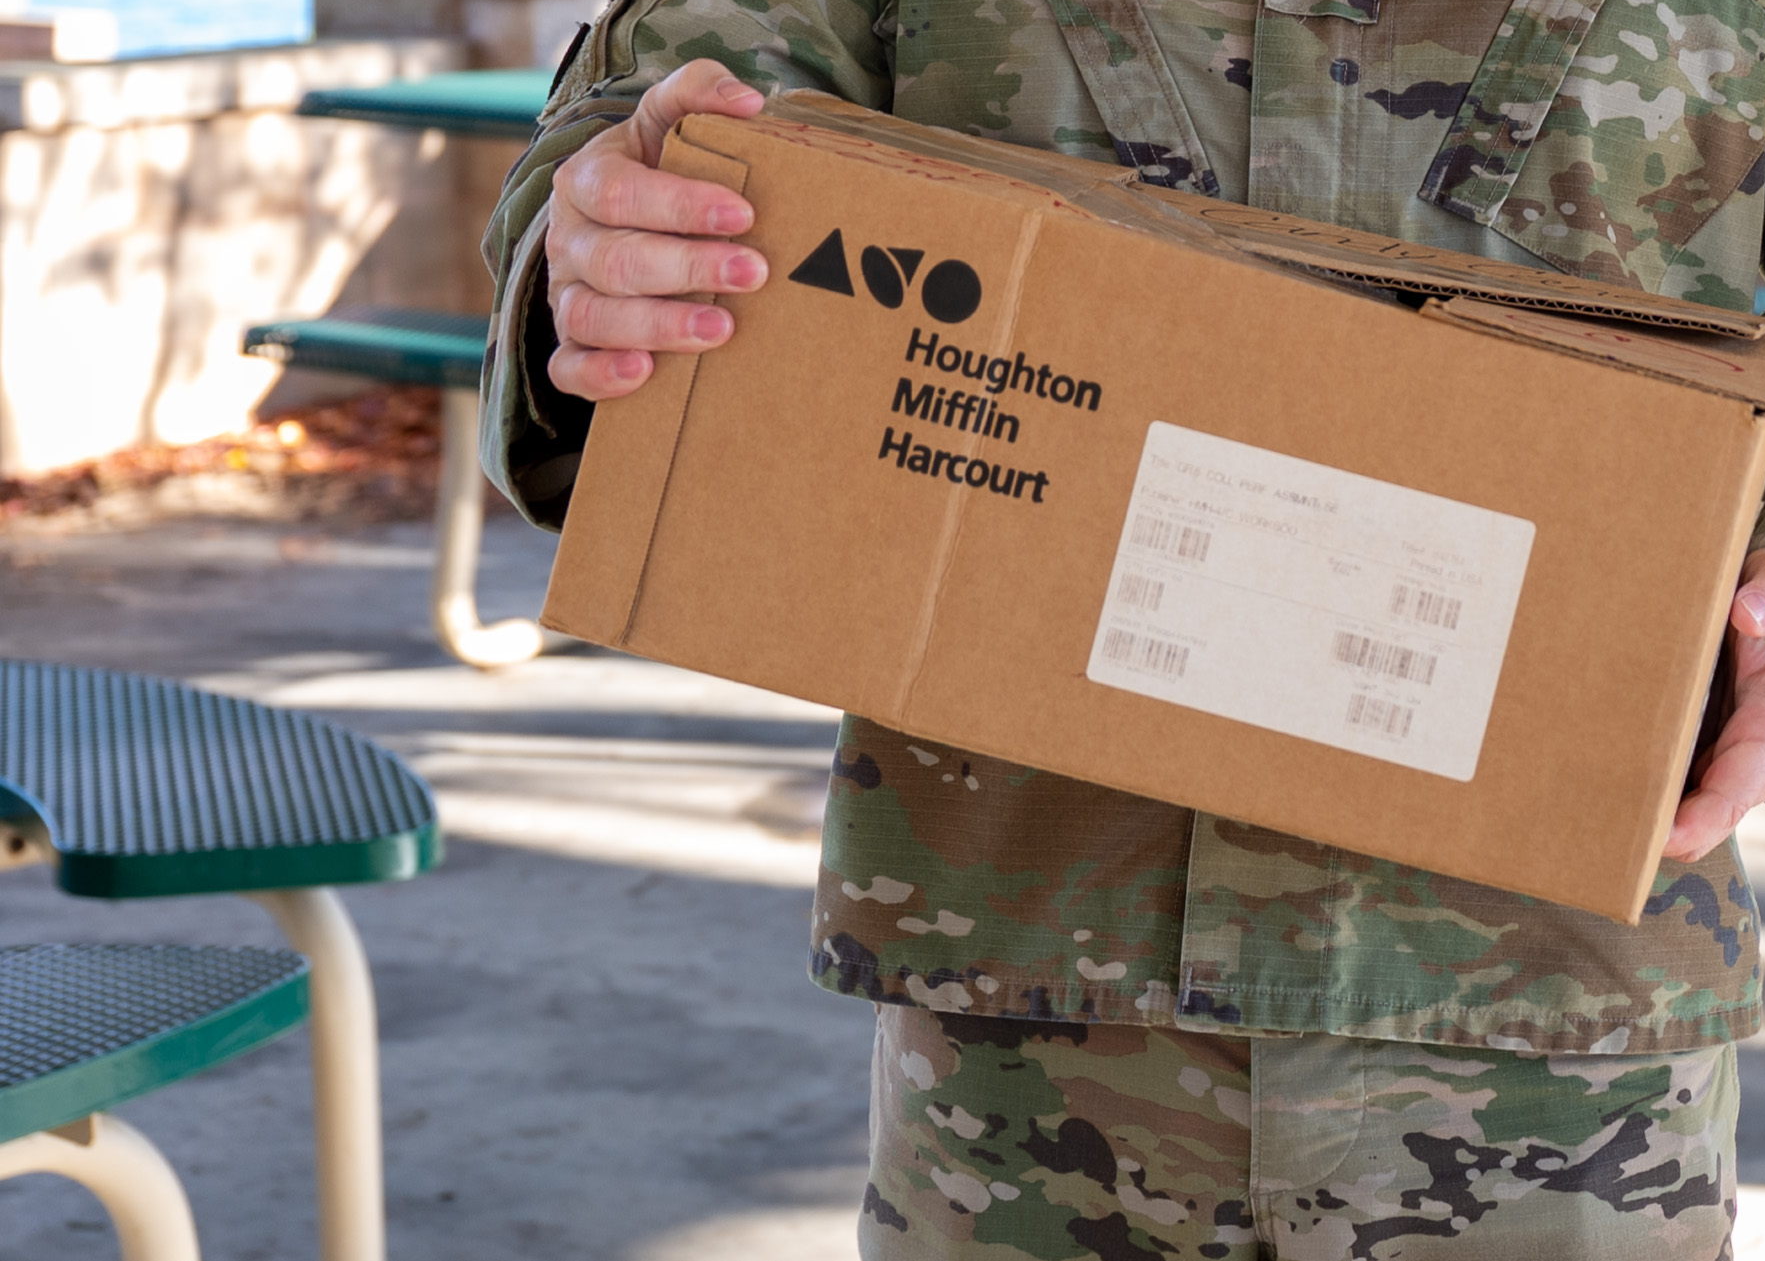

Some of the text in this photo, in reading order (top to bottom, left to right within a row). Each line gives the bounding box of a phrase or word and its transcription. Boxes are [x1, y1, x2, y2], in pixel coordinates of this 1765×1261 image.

[905, 327, 1102, 411] Houghton
[891, 377, 1020, 443] Mifflin
[878, 426, 1049, 503] Harcourt
